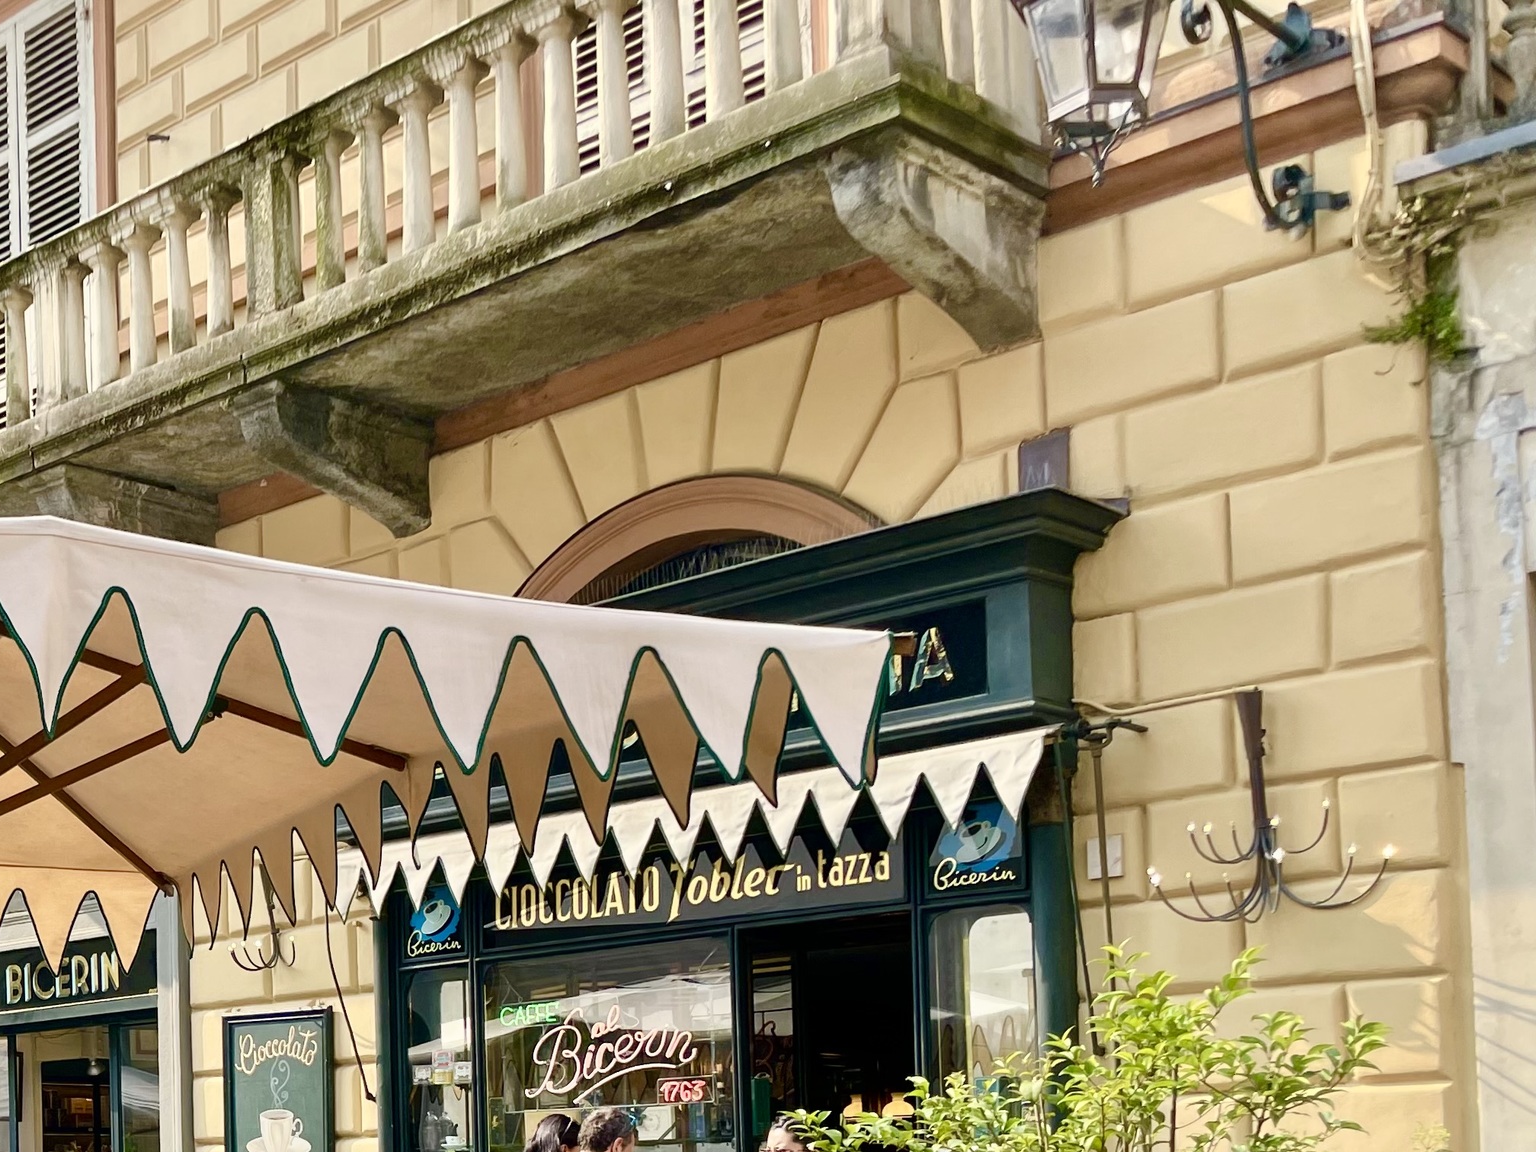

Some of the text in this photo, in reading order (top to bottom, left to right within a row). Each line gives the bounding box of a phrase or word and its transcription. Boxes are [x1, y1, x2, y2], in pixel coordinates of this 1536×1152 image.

[495, 849, 891, 931] CIOCCOLATO Tobler in tazza
[933, 857, 1016, 891] Bicerin
[407, 929, 462, 957] Bicerin
[5, 950, 120, 1005] BICERIN
[591, 1004, 621, 1039] al
[234, 1025, 318, 1075] Cioccolato
[525, 1008, 698, 1099] Bicerin
[660, 1080, 706, 1102] 1763
